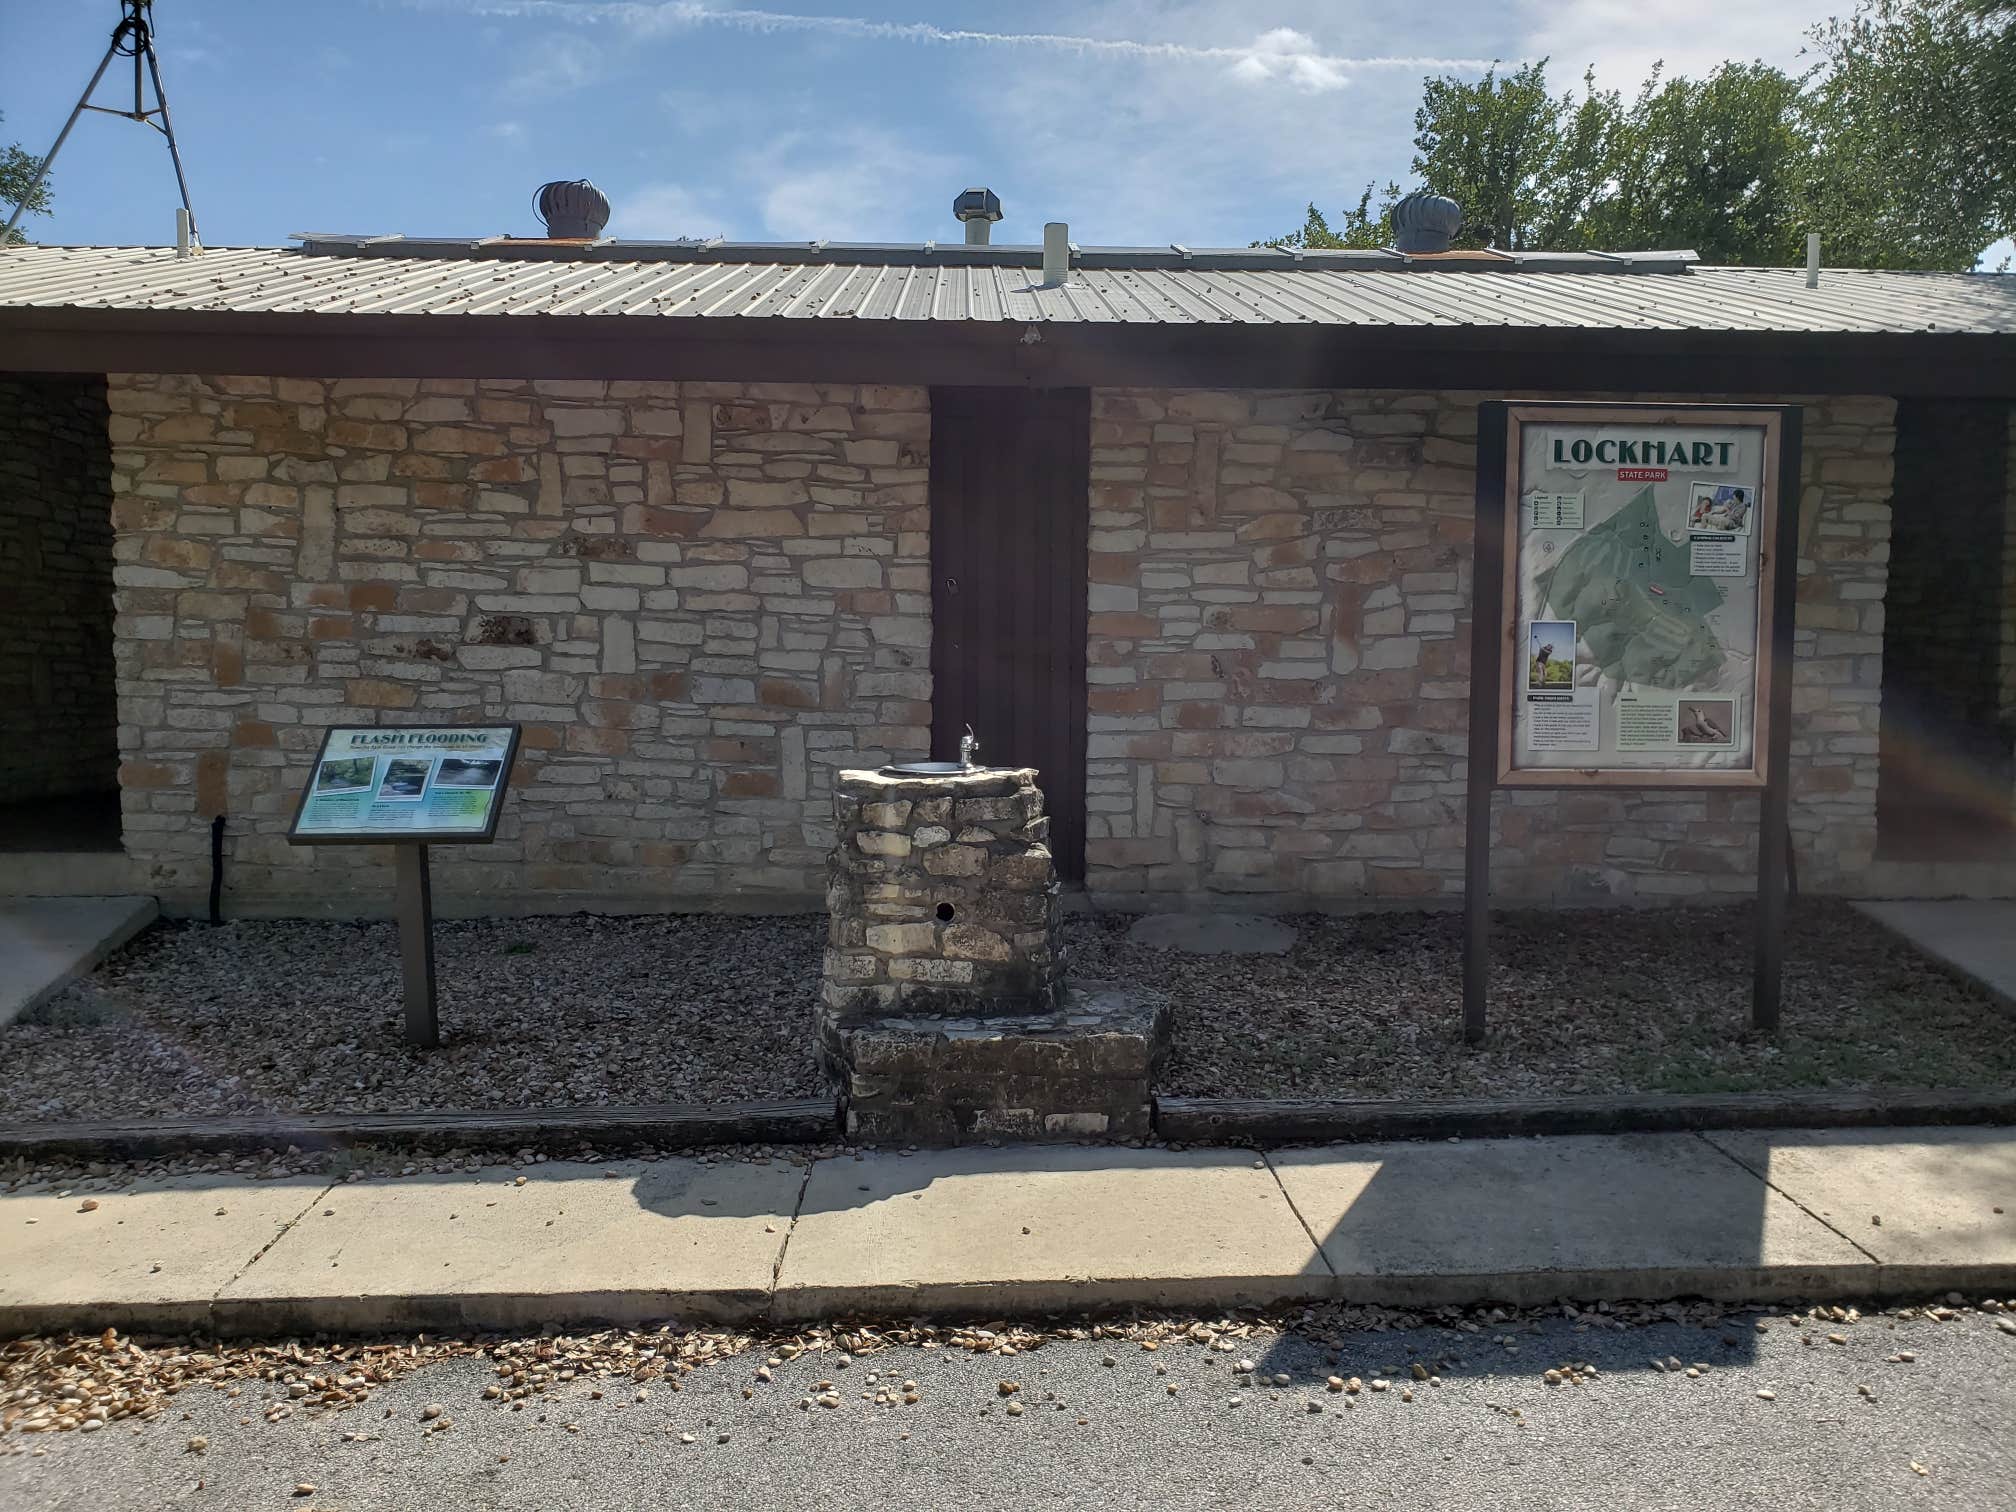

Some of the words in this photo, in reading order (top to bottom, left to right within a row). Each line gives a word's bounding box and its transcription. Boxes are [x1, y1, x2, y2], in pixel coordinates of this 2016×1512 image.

[1553, 439, 1735, 466] LOCKHART
[1619, 471, 1645, 480] STATE
[1645, 471, 1666, 480] PARK
[350, 734, 403, 745] FLASH
[407, 733, 488, 744] FLOODING
